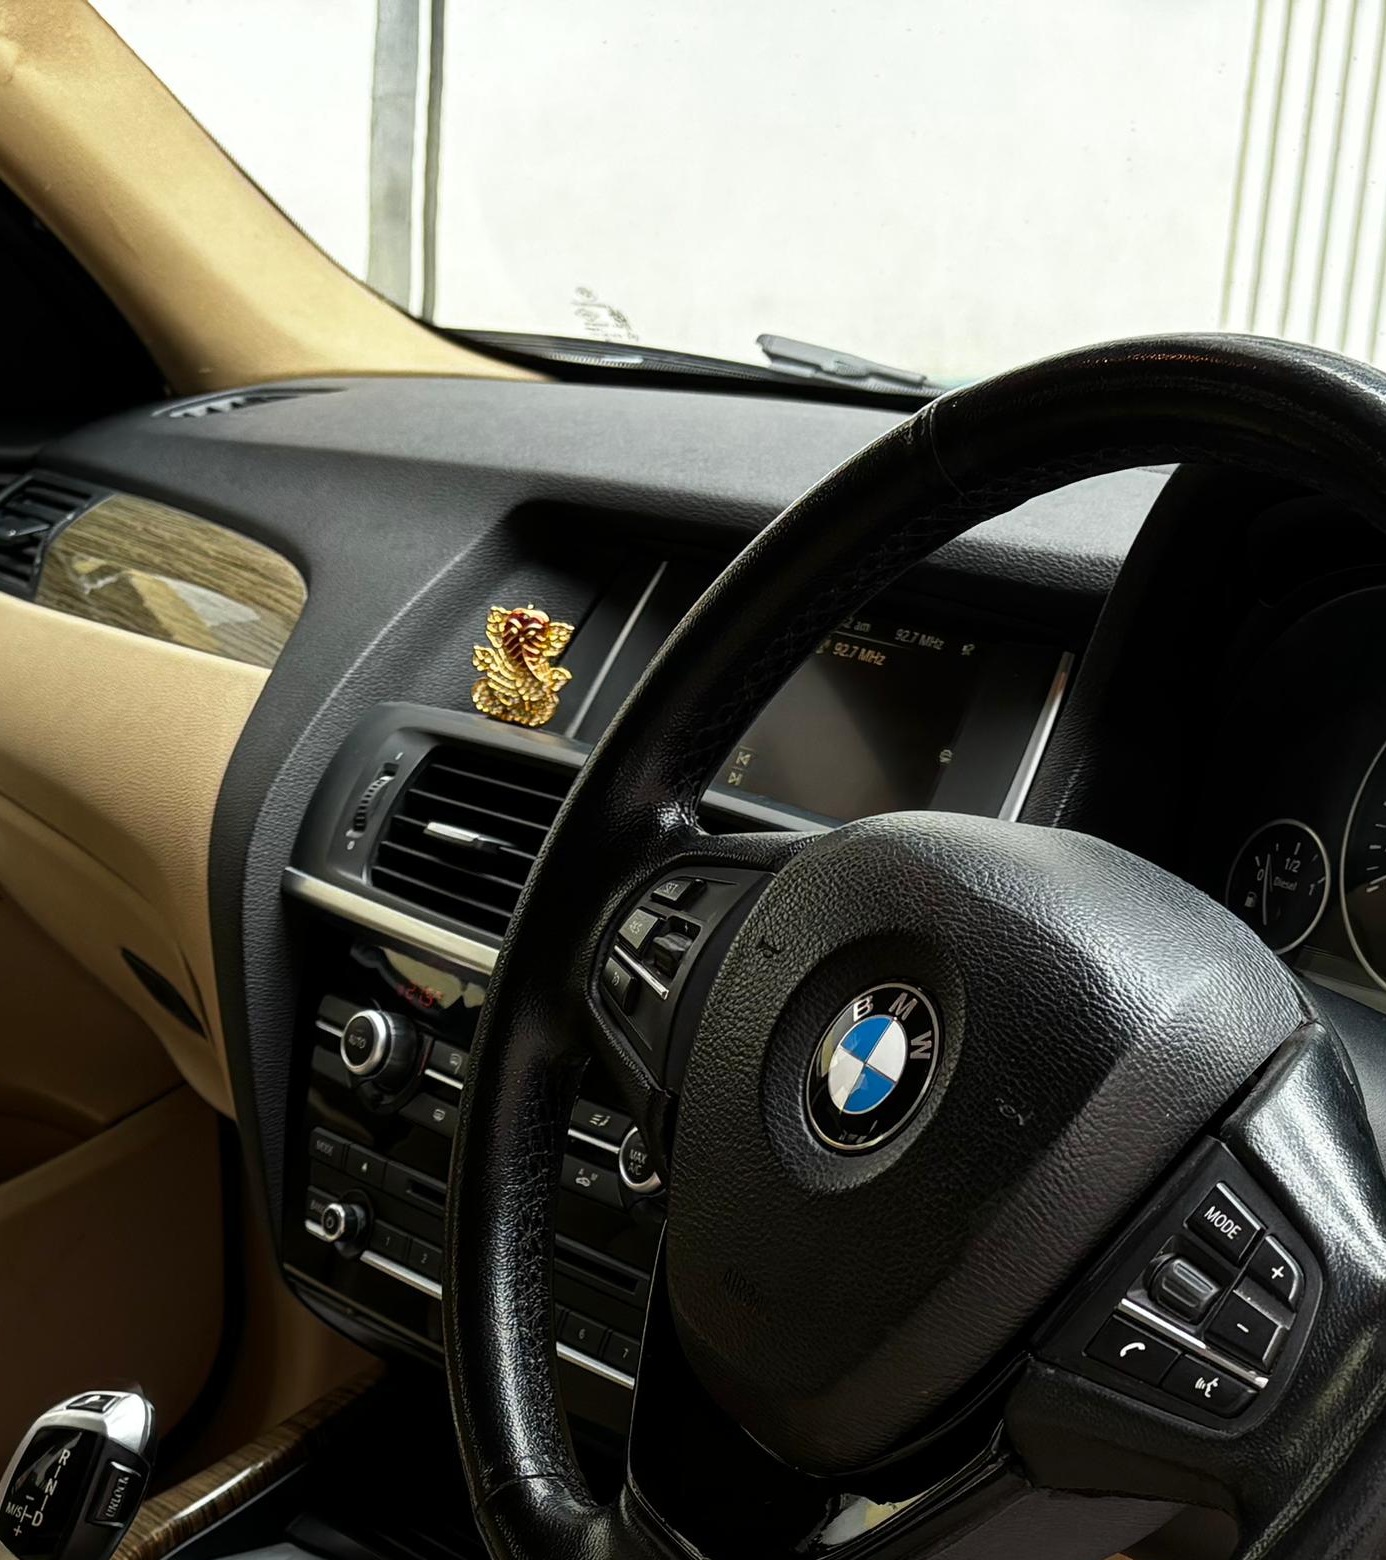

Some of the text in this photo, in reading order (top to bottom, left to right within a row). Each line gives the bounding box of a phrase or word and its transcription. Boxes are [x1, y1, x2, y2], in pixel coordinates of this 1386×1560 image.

[894, 628, 944, 650] 92.7 MHz
[833, 642, 886, 666] 92.7 MHz
[1284, 857, 1301, 873] 1/2
[1256, 868, 1265, 881] 0
[1273, 876, 1298, 891] Diesel
[1308, 883, 1316, 896] 1
[853, 992, 933, 1060] BMW
[1203, 1205, 1242, 1241] MODE
[421, 1253, 428, 1264] 2
[579, 1328, 586, 1340] 6
[622, 1347, 629, 1359] 7
[59, 1448, 71, 1466] R
[44, 1477, 58, 1496] N
[105, 1476, 130, 1518] UNLOCK
[5, 1501, 24, 1519] M/S
[31, 1510, 44, 1527] D
